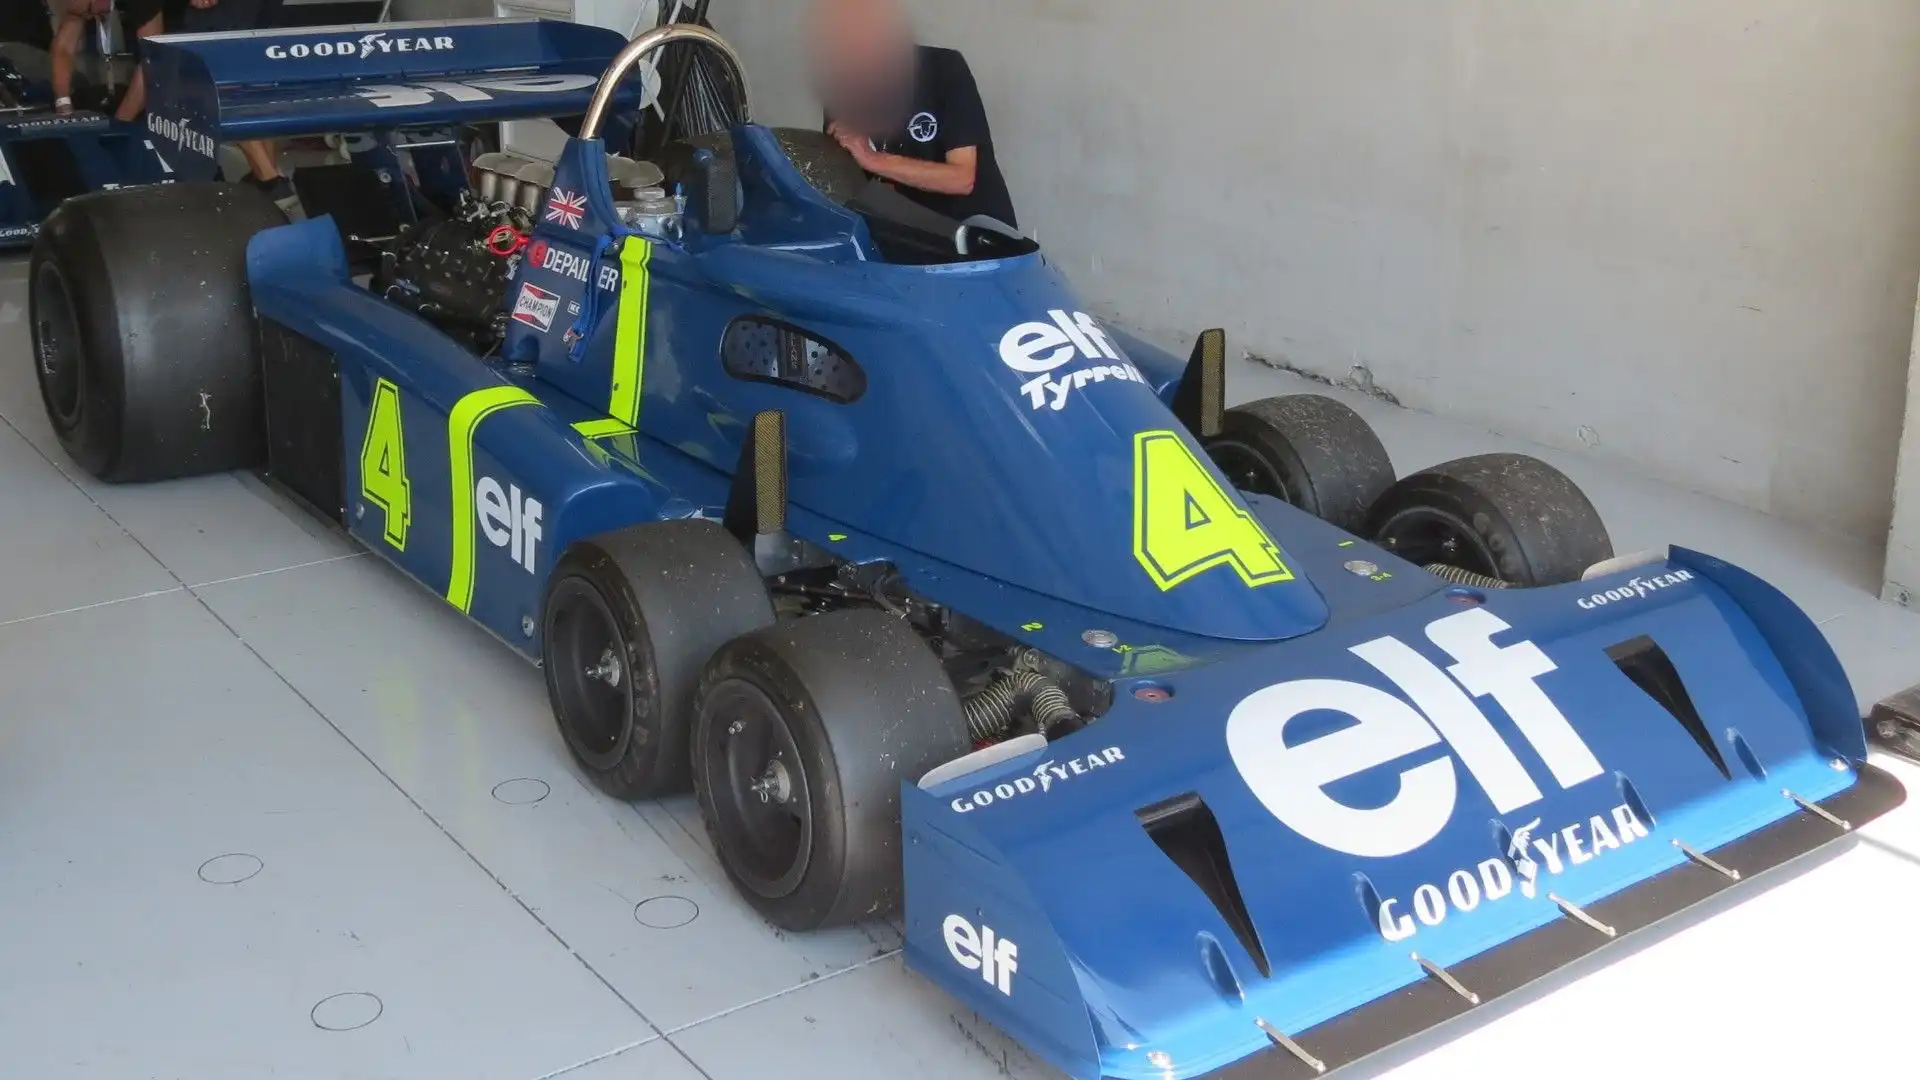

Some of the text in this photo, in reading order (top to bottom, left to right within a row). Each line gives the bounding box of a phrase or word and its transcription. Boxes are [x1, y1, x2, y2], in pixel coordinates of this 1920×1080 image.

[265, 32, 455, 60] GOODYEAR
[147, 112, 214, 159] GOODYEAR
[543, 247, 619, 292] DEPAILER
[518, 294, 555, 319] CHAMPION
[999, 309, 1120, 372] elf
[1020, 364, 1146, 411] Tyrrell
[361, 376, 411, 552] 4
[475, 476, 543, 574] elf
[1133, 430, 1295, 591] 4
[1577, 569, 1695, 609] GOODYEAR
[1226, 606, 1605, 857] elf
[951, 746, 1125, 813] GOODYEAR
[1378, 803, 1650, 943] GOODYEAR
[943, 914, 1018, 996] elf
